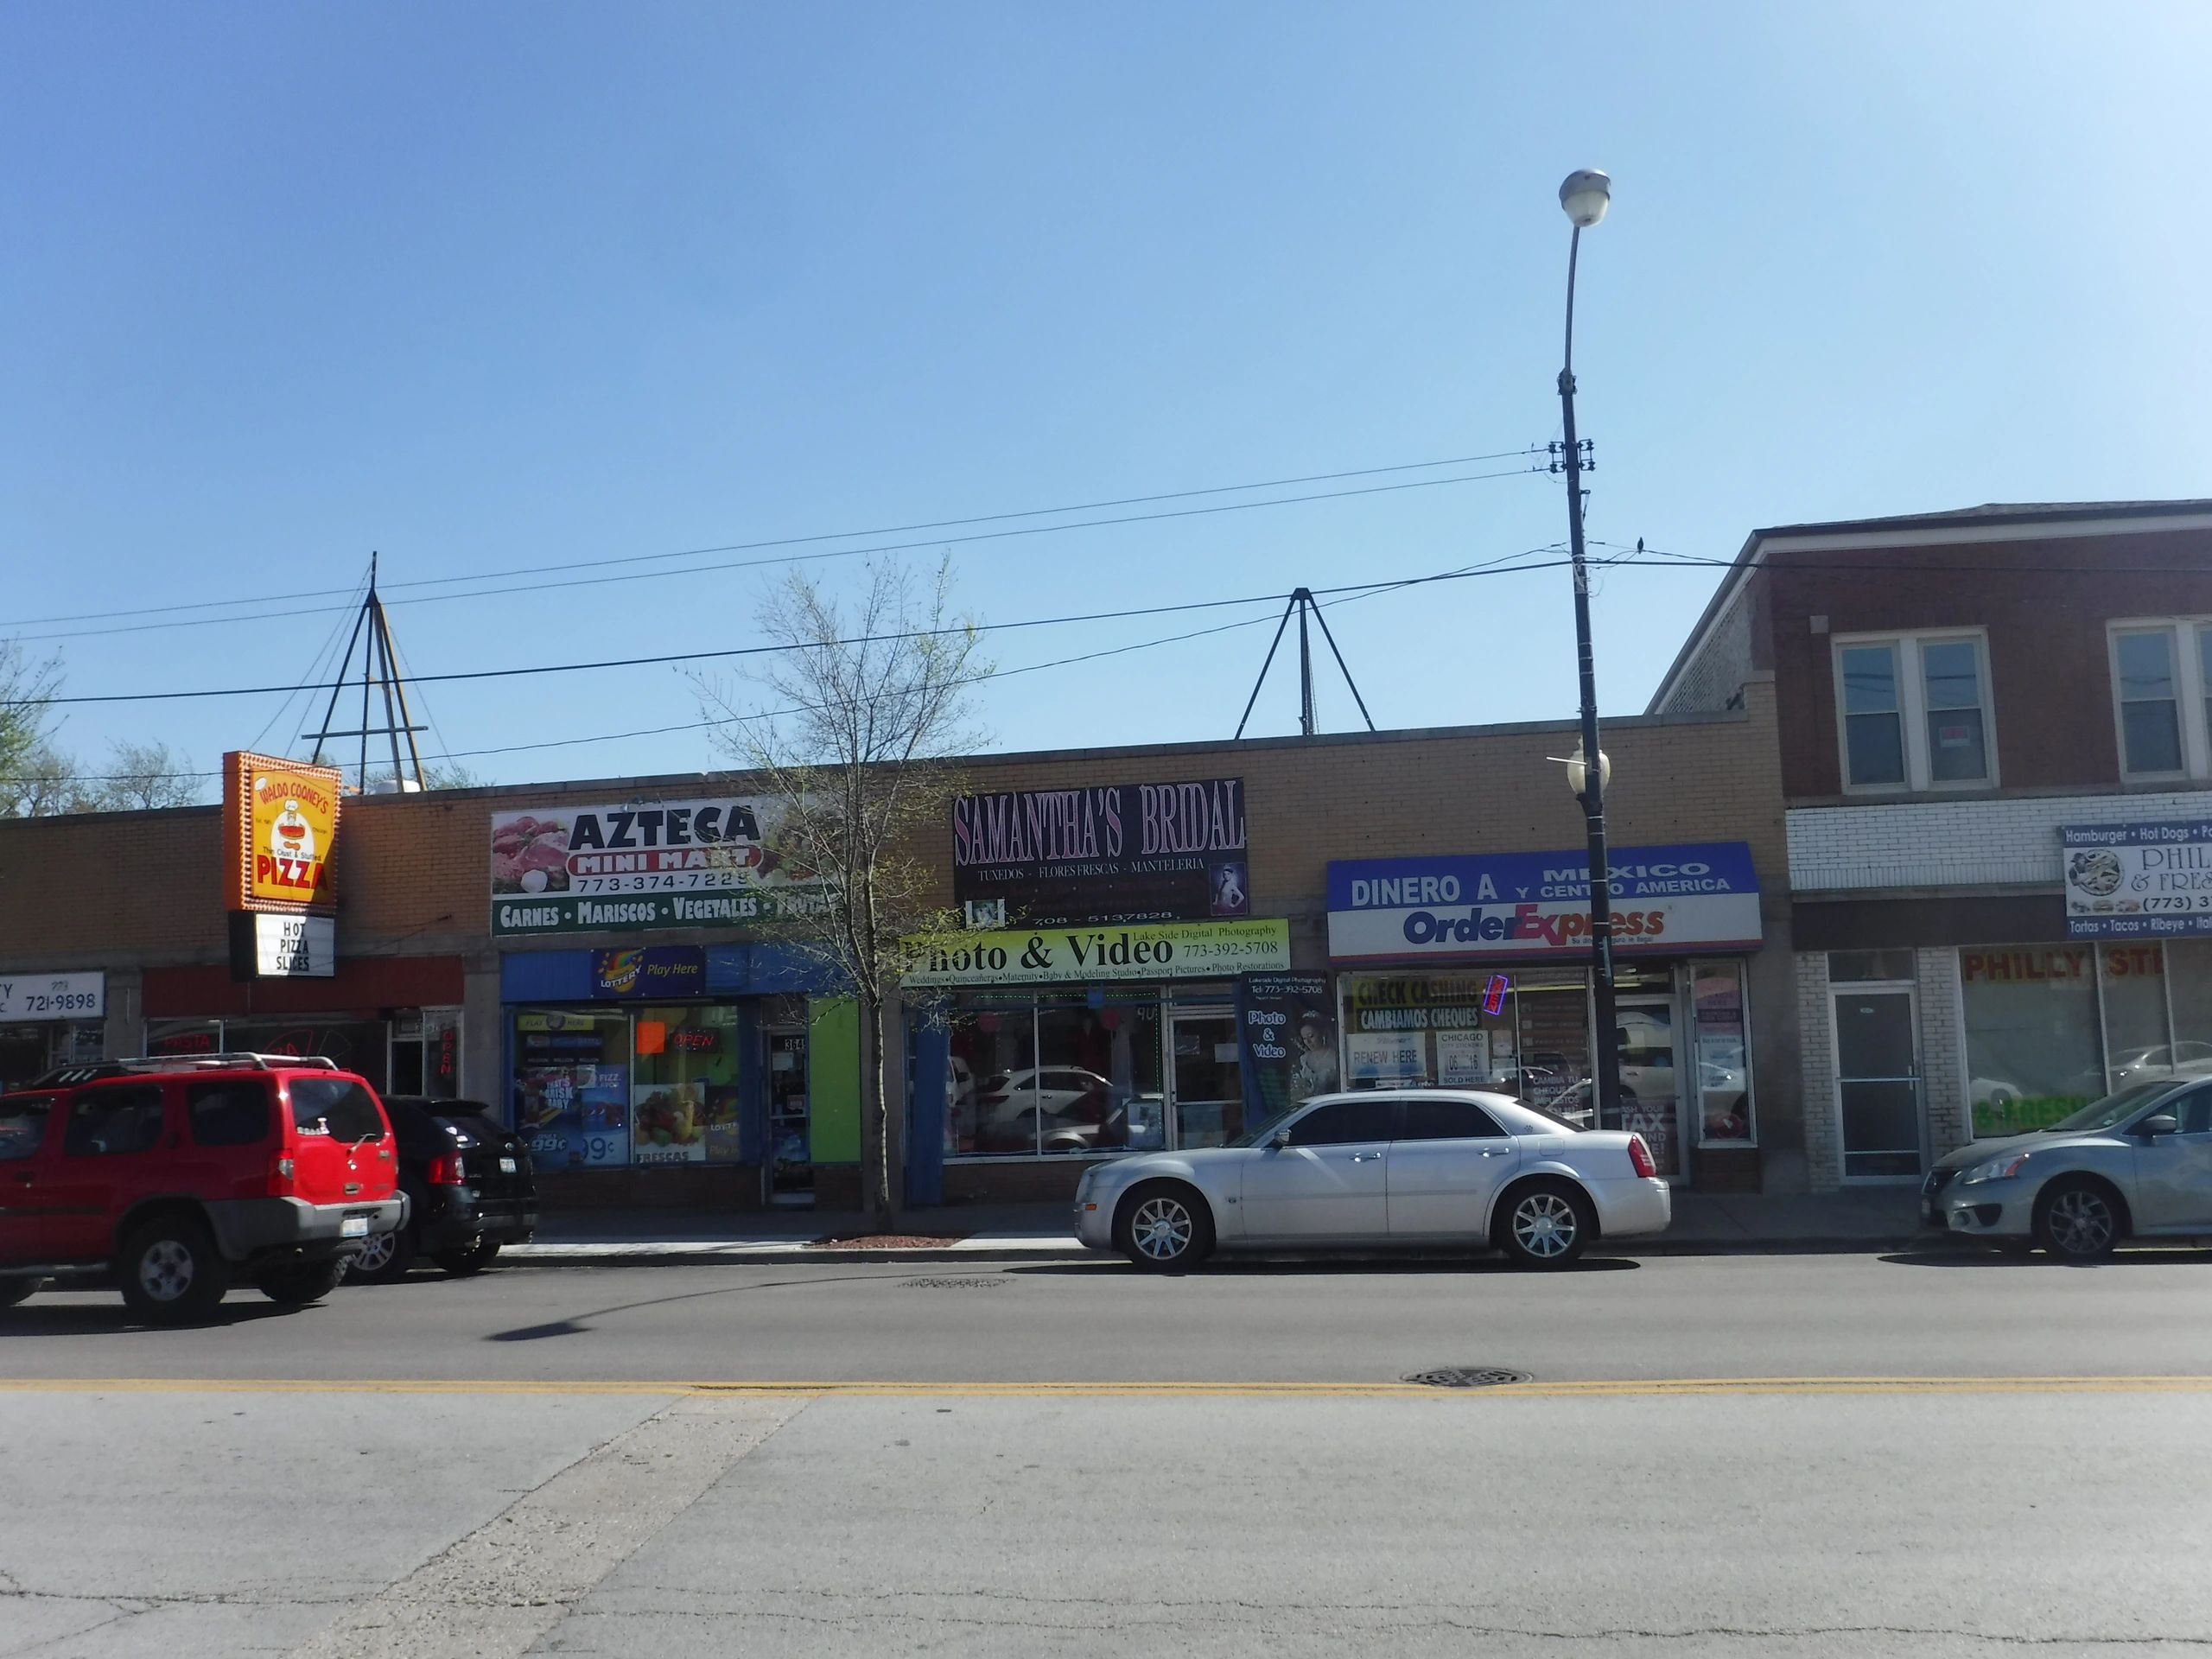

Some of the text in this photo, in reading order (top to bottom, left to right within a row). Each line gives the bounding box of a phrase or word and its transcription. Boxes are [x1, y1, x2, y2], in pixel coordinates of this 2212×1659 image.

[259, 782, 329, 814] WALDO COONEY'S
[568, 804, 761, 851] AZTECA
[953, 780, 1245, 867] SAMANTHA'S BRIDAL
[2065, 830, 2127, 843] Hamburger
[2139, 827, 2158, 840] Hot
[2161, 826, 2190, 841] Dogs
[263, 846, 275, 855] Thin
[276, 849, 292, 858] Crust
[301, 852, 321, 861] Stuffed
[577, 854, 648, 874] MINI
[978, 858, 1205, 881] TUXEDOS FLORES FRESCAS MANTELERIA
[257, 855, 329, 891] PIZZA
[1351, 873, 1498, 906] DINERO A
[1515, 878, 1731, 899] Y CENTO AMERICA
[2131, 874, 2151, 892] &
[2143, 896, 2192, 912] (773)
[500, 905, 560, 928] CARNES
[577, 901, 656, 925] MARISCOS
[672, 897, 758, 920] VEGETALES
[1033, 912, 1173, 925] 708 5137828
[283, 922, 305, 937] HOT
[1133, 925, 1277, 941] Lake Side Digital Photography
[2070, 921, 2100, 933] Tortas
[2110, 919, 2139, 931] Tacos
[2151, 918, 2185, 932] Ribeye
[280, 939, 309, 954] PIZZA
[1020, 937, 1053, 969] &
[1066, 933, 1173, 967] Video
[1183, 941, 1279, 957] 773-392-5708
[276, 956, 309, 971] SLICES
[647, 962, 698, 977] Play Here
[1965, 949, 2083, 982] PHILLY
[601, 964, 641, 988] LOTTERY
[909, 975, 945, 985] Weddings
[1002, 972, 1038, 983] Maternity
[1043, 969, 1062, 981] Baby
[1065, 969, 1071, 979] &
[1074, 967, 1110, 980] Modeling
[1112, 967, 1136, 977] Studio
[1141, 965, 1173, 977] Passport
[1175, 963, 1205, 974] Pictures
[1211, 963, 1235, 973] Photo
[1236, 961, 1285, 971] Restorations
[1265, 985, 1323, 994] 773-392-5708
[1358, 981, 1407, 1005] CHECK
[1248, 1010, 1287, 1025] Photo
[1361, 1007, 1478, 1029] CAMBIAMOS CHEQUES
[674, 1033, 714, 1047] OPEN
[1262, 1028, 1274, 1041] &
[1441, 1033, 1484, 1042] CHICAGO
[1252, 1043, 1287, 1058] Video
[1354, 1049, 1418, 1065] RENEW HERE
